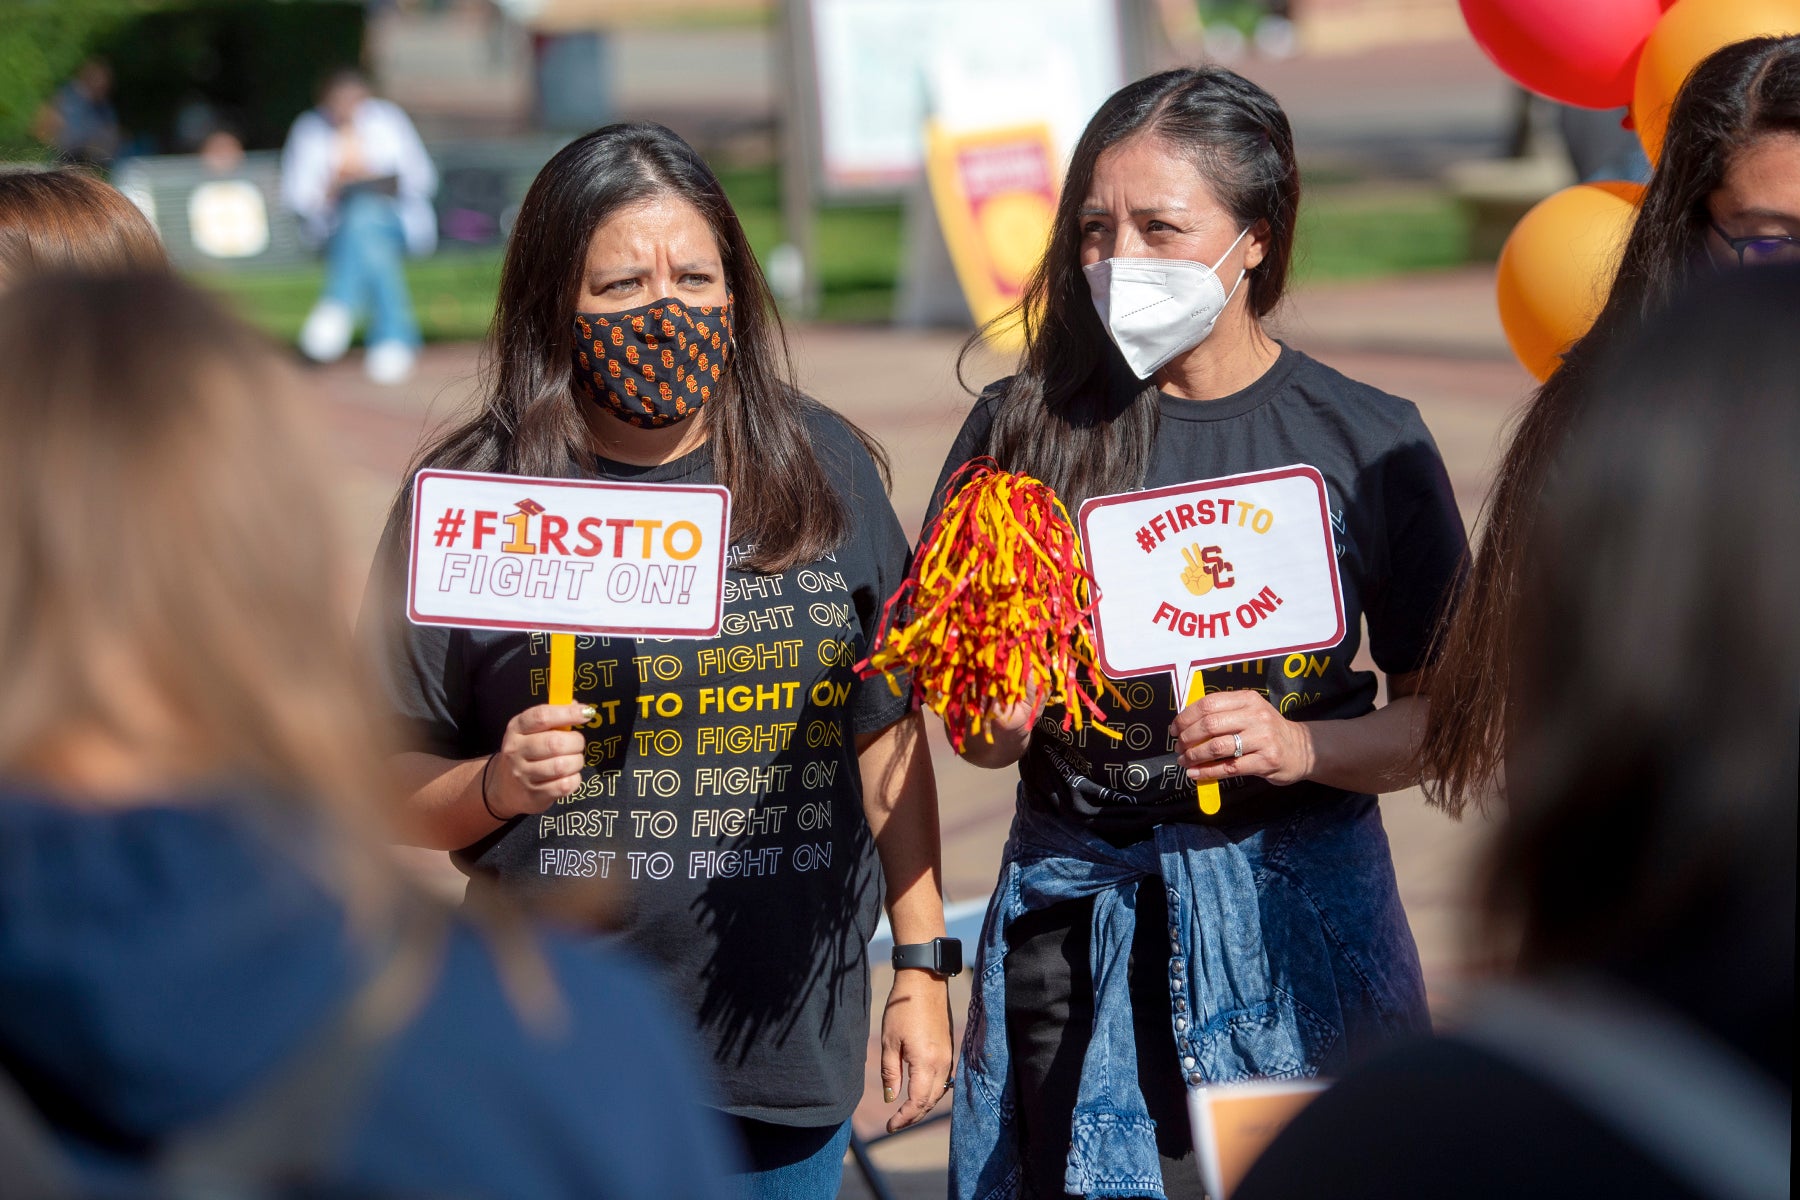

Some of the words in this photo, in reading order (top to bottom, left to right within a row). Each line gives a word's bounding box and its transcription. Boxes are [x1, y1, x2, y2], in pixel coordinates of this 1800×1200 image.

[439, 553, 594, 601] FIGHT
[607, 563, 696, 605] ON!
[722, 574, 784, 603] GHT
[797, 570, 849, 593] ON
[1201, 545, 1235, 589] SC
[721, 605, 794, 636] GHT
[808, 602, 852, 630] ON
[1152, 601, 1231, 638] FIGHT
[1235, 585, 1283, 629] ON!
[530, 660, 618, 696] FST
[632, 655, 683, 683] TO
[698, 640, 803, 676] FIGHT
[817, 639, 856, 667] ON
[1283, 652, 1331, 679] ON
[635, 693, 683, 719] TO
[699, 682, 801, 714] FIGHT
[811, 680, 852, 707] ON
[634, 729, 683, 757] TO
[697, 723, 798, 755] FIGHT
[806, 720, 842, 748] ON
[633, 769, 681, 797] TO
[695, 765, 792, 796] FIGHT
[802, 760, 838, 790] ON
[1104, 763, 1150, 792] TO
[539, 809, 619, 839] FIRST
[631, 810, 678, 838] TO
[691, 806, 787, 837] FIGHT
[797, 800, 832, 831] ON
[540, 848, 616, 878] FIRST
[627, 851, 674, 880] TO
[688, 847, 783, 879] FIGHT
[792, 841, 833, 872] ON
